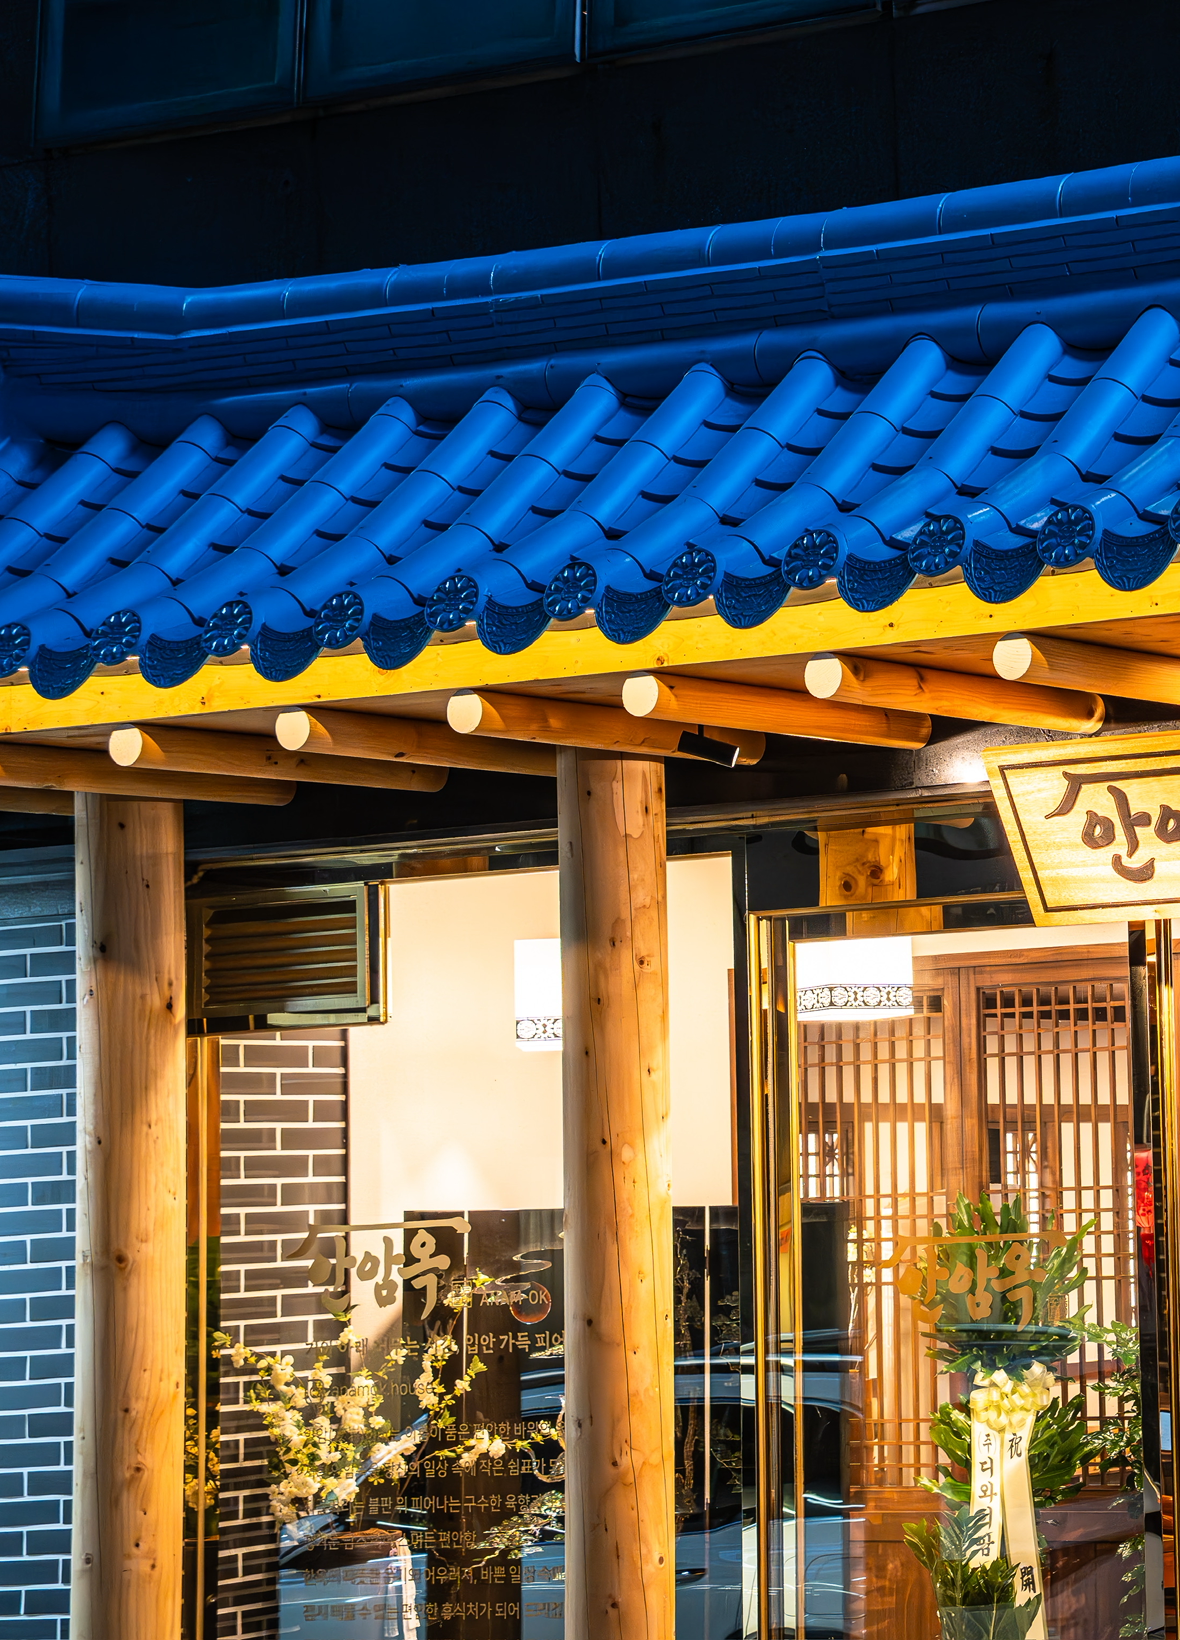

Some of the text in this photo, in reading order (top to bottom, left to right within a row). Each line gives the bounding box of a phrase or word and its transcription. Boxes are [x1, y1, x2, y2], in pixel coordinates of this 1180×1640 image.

[307, 1228, 450, 1321] 안암옥
[528, 1290, 549, 1305] OK
[898, 1244, 1047, 1332] 안암옥
[465, 1331, 496, 1354] 입안
[499, 1331, 531, 1353] 가득
[445, 1423, 470, 1441] 품은
[423, 1459, 449, 1478] 일상
[479, 1459, 505, 1477] 작은
[411, 1495, 462, 1514] 피어나는
[464, 1494, 502, 1513] 구수한
[481, 1565, 506, 1584] 바쁜
[495, 1602, 520, 1620] 되어
